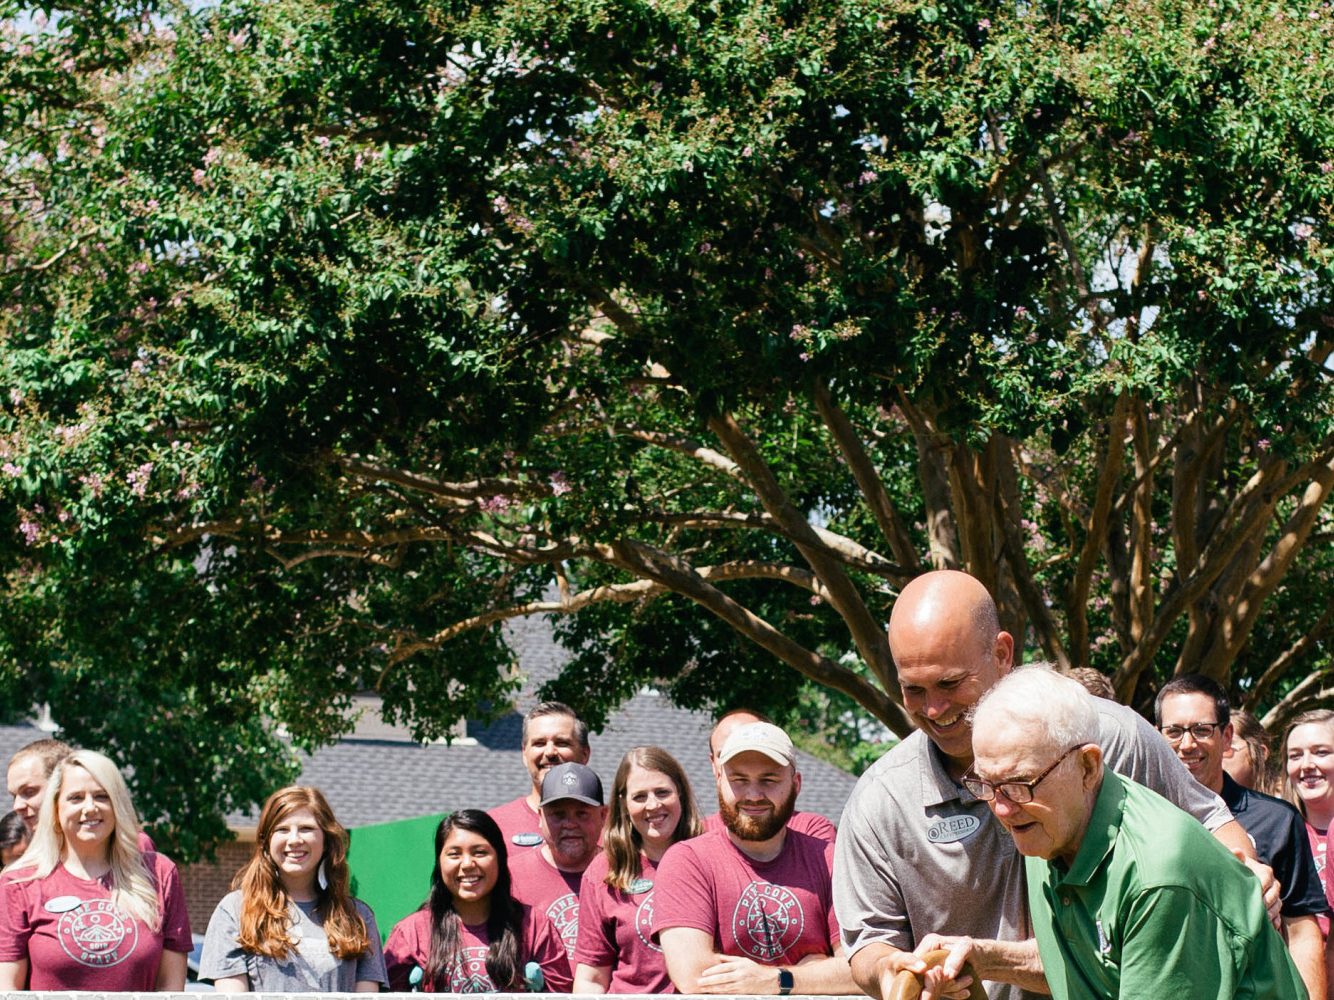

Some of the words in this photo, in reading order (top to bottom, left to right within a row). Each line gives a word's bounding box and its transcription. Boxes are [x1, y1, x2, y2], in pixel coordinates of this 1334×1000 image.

[938, 816, 974, 835] REED
[549, 896, 575, 919] PINE
[764, 886, 796, 909] COVE
[63, 903, 91, 923] PINE
[80, 951, 118, 964] STAFF
